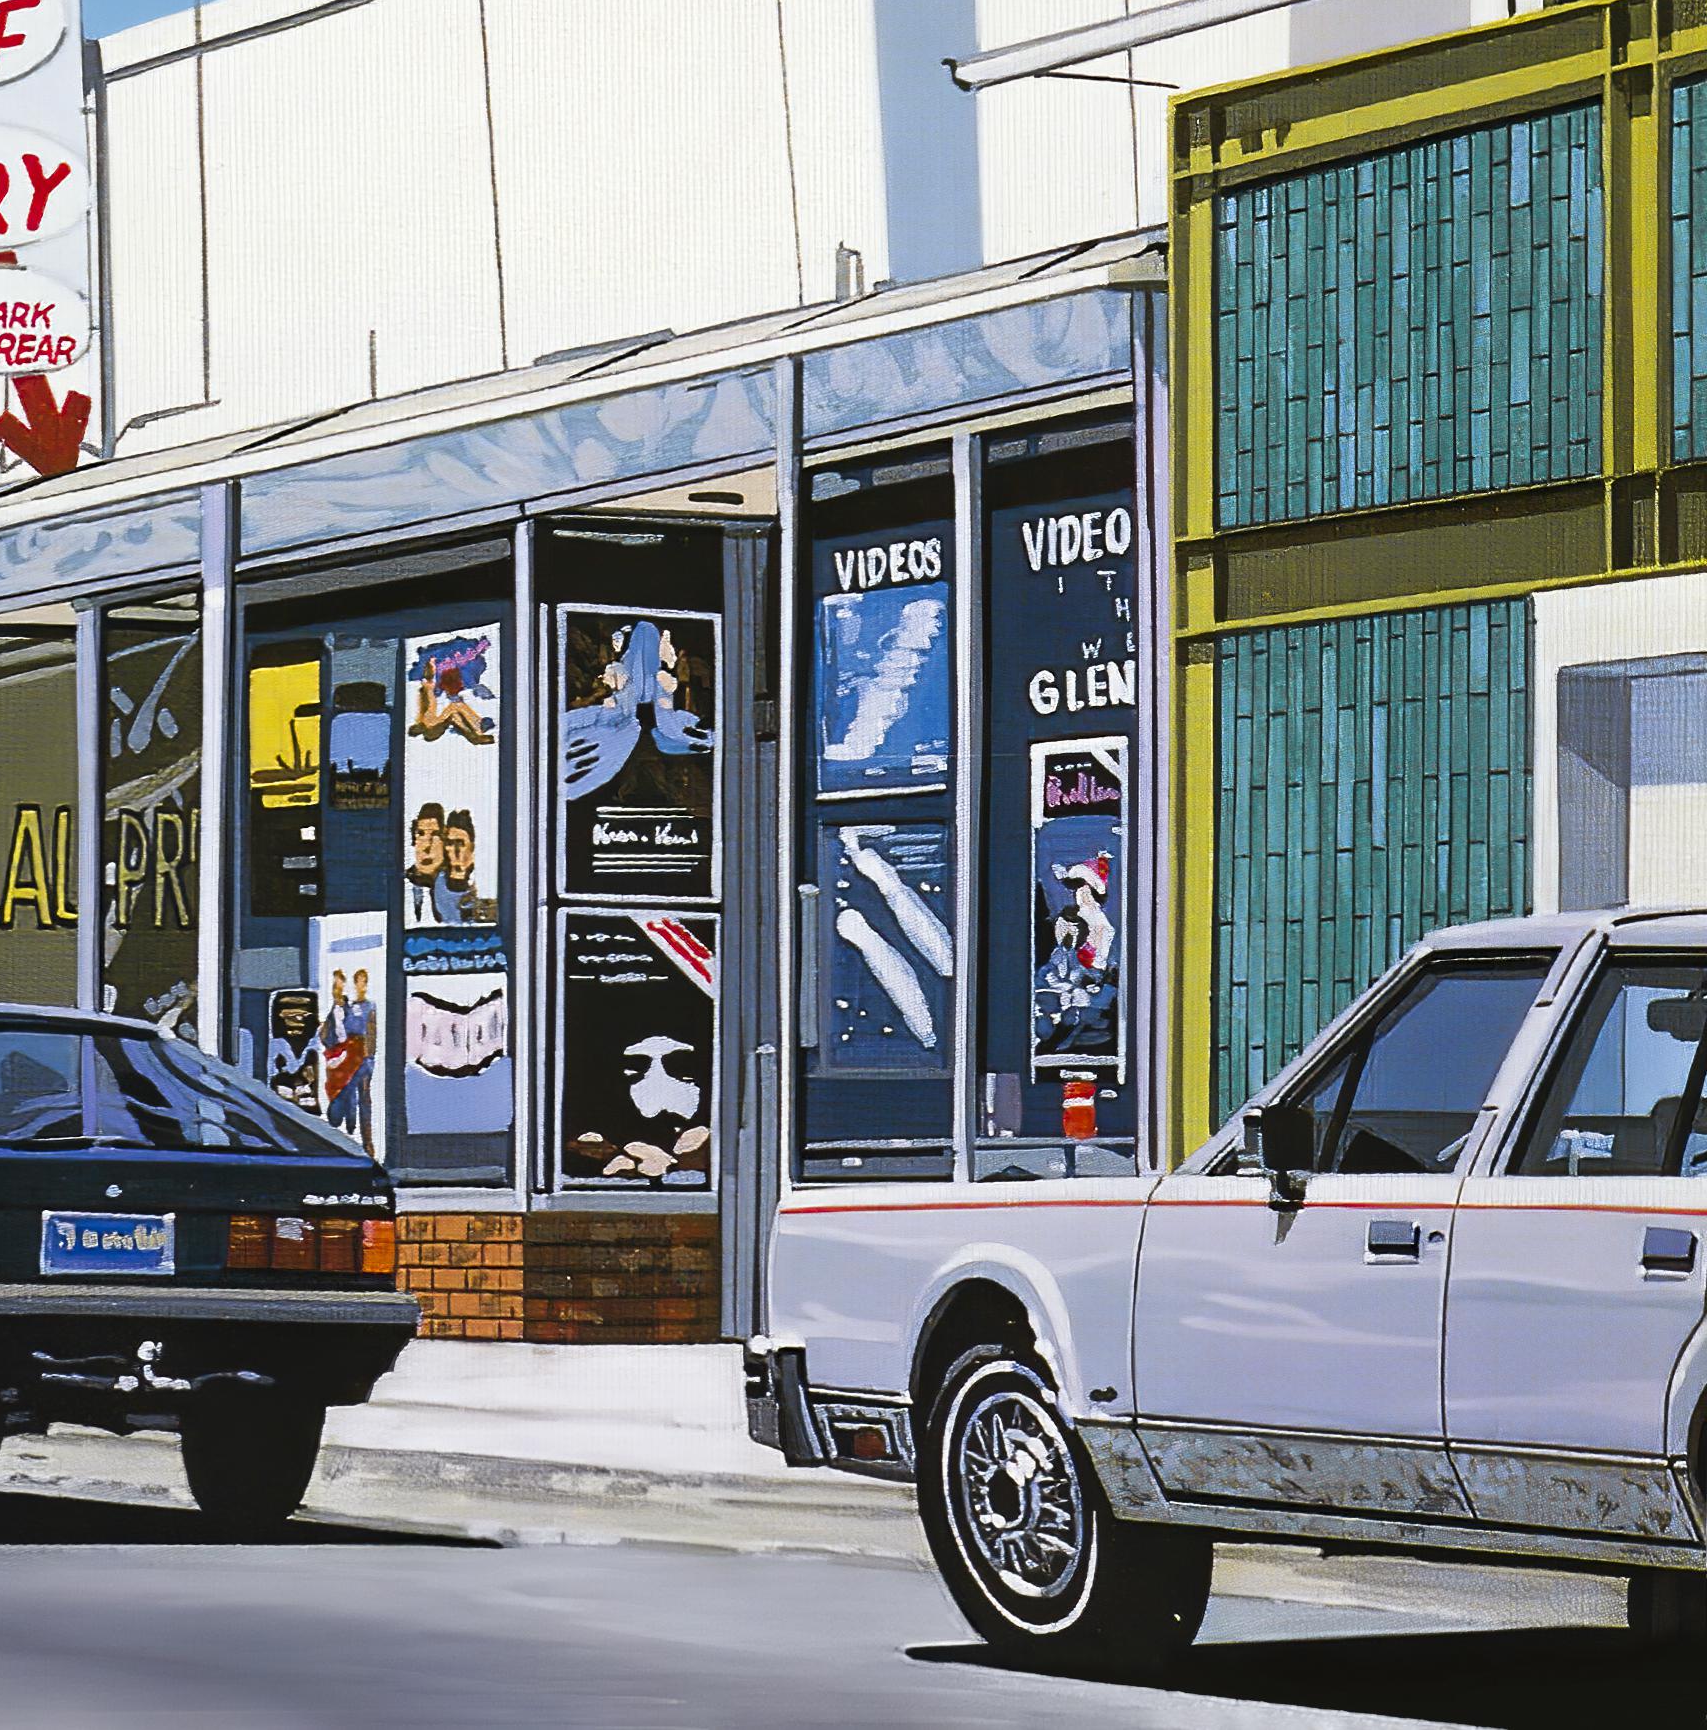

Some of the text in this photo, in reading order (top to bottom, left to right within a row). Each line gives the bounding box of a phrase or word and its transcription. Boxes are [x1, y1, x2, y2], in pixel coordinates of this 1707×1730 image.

[834, 538, 941, 591] VIDEOS
[1022, 507, 1132, 571] VIDEO
[1029, 660, 1136, 715] GLEN
